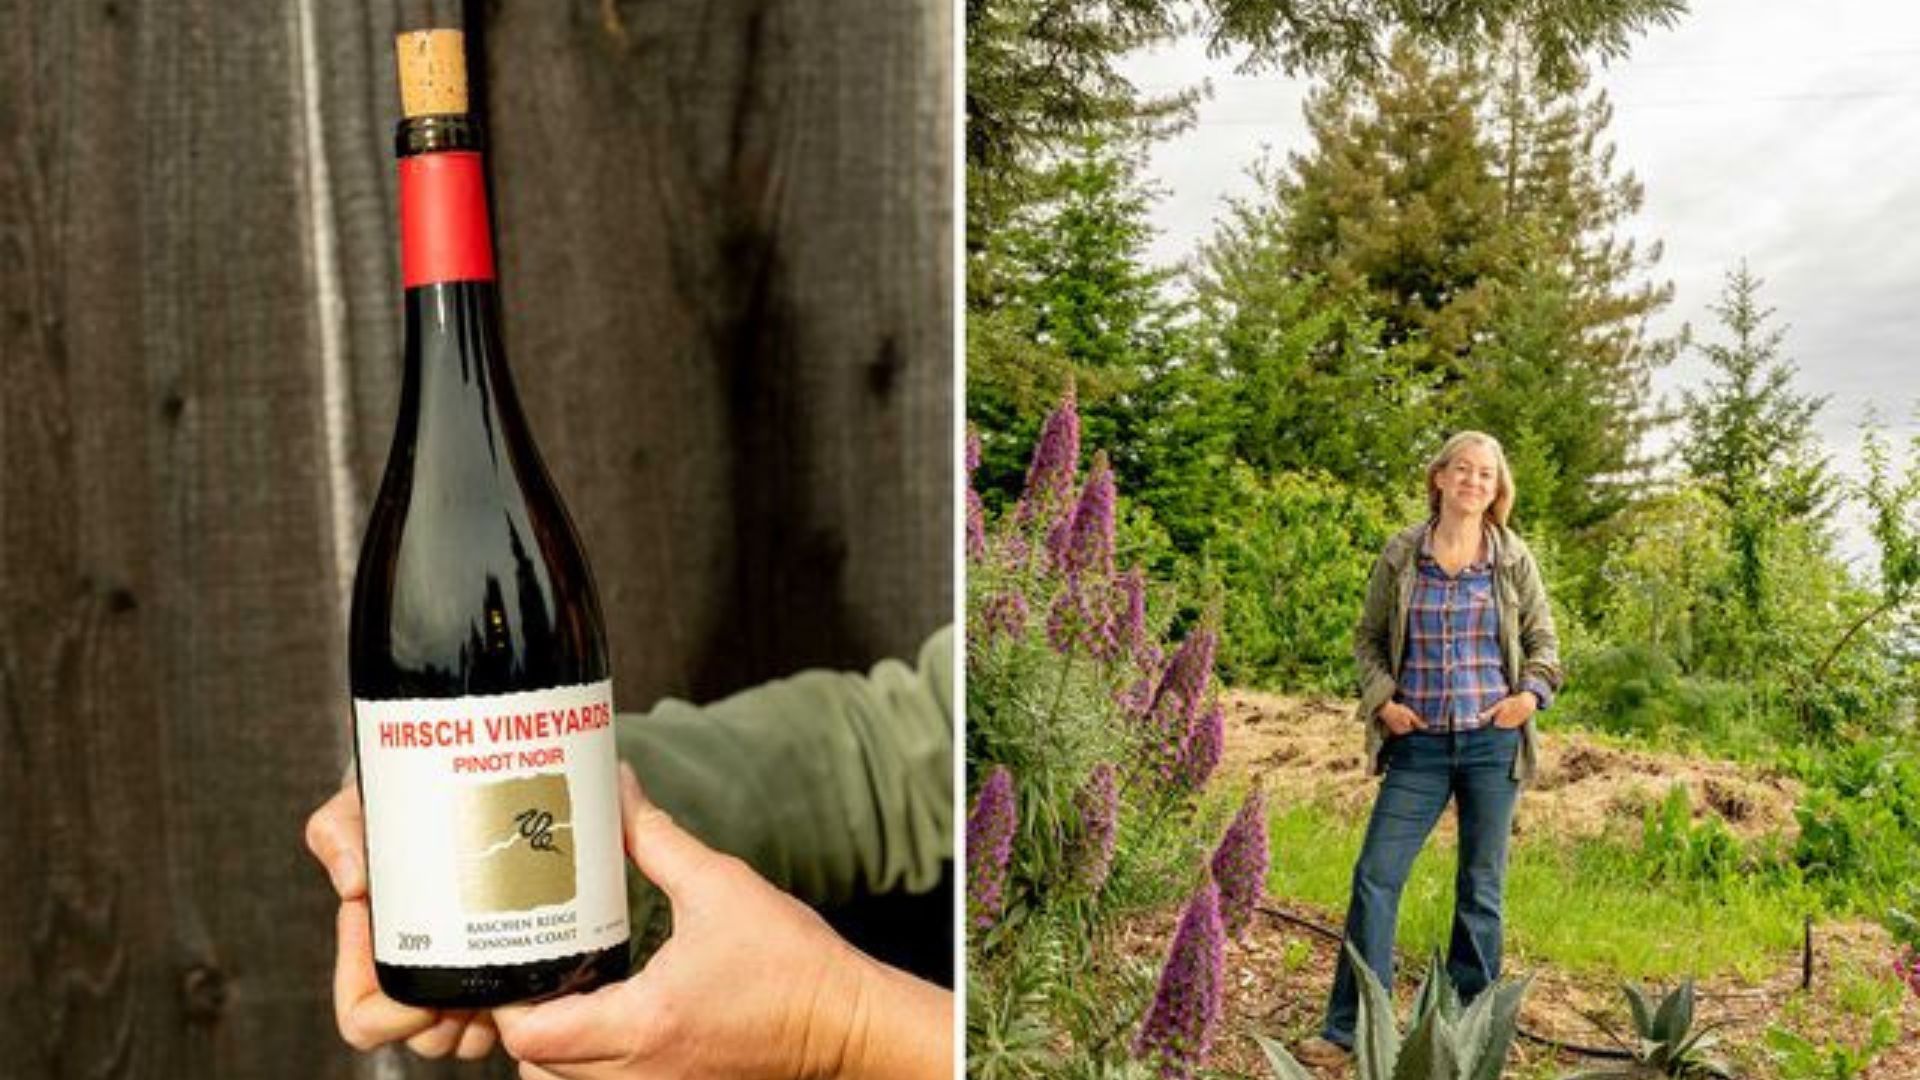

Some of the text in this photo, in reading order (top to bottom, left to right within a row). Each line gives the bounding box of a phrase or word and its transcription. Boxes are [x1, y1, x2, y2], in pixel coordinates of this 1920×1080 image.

[379, 702, 610, 748] HIRSCH VINEYARDS
[453, 747, 565, 773] PINOT NOIR
[397, 932, 432, 950] 2019
[467, 928, 577, 950] SONOMA COAST
